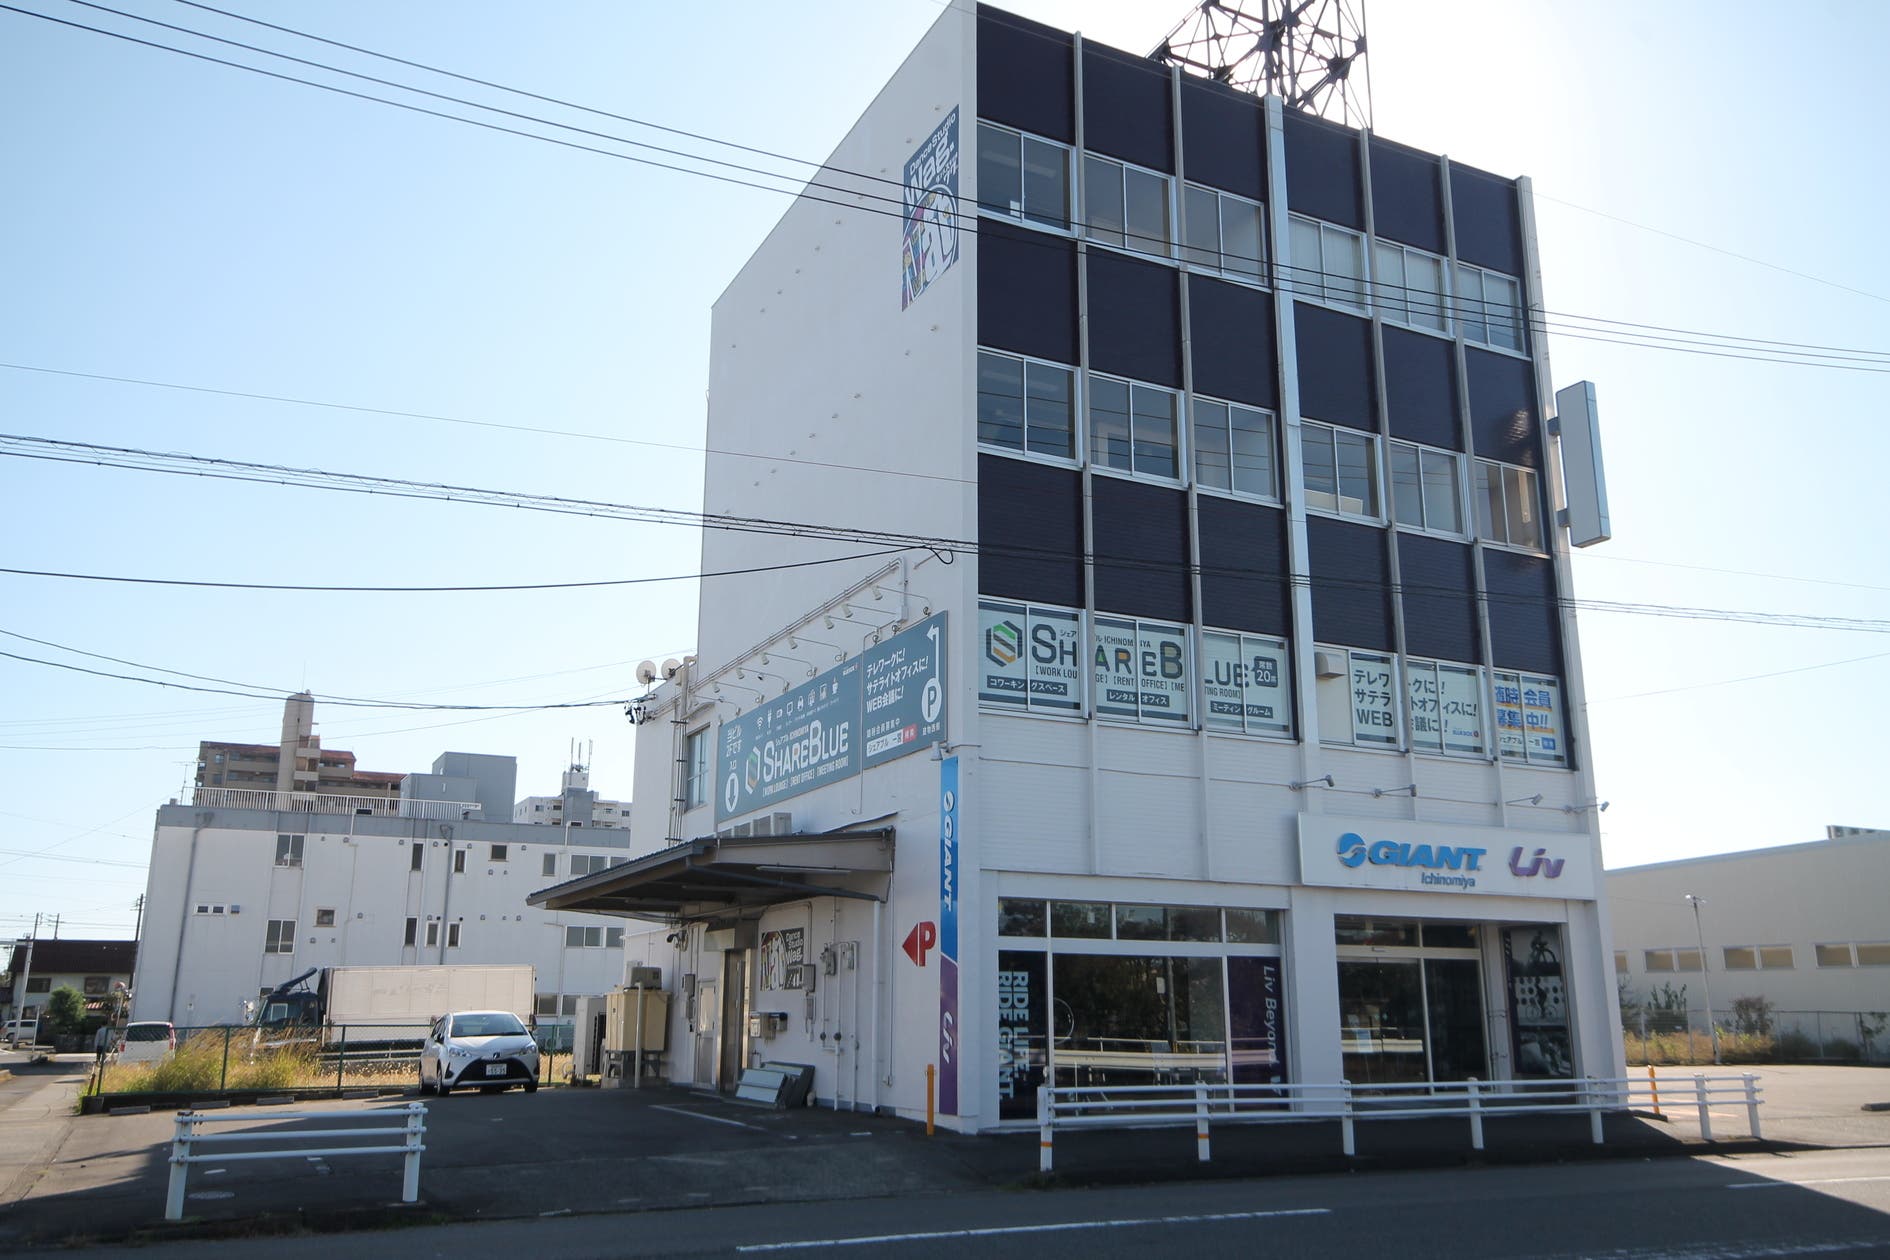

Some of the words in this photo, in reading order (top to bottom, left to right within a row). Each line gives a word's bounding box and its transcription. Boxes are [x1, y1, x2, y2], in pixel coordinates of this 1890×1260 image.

[909, 142, 932, 176] Dance
[932, 112, 956, 148] Studio
[927, 685, 938, 718] P
[990, 677, 1066, 694] コワーキングスペース
[1109, 691, 1168, 706] レンタルオフィス
[1212, 701, 1271, 716] ミーティングルーム
[1367, 839, 1487, 871] GIANT
[1420, 871, 1476, 889] Ichinomiya
[919, 920, 937, 967] P
[1263, 965, 1276, 992] Liv
[999, 970, 1013, 1021] RIDE
[1013, 970, 1030, 1021] RIDE
[1263, 997, 1280, 1067] Beyond
